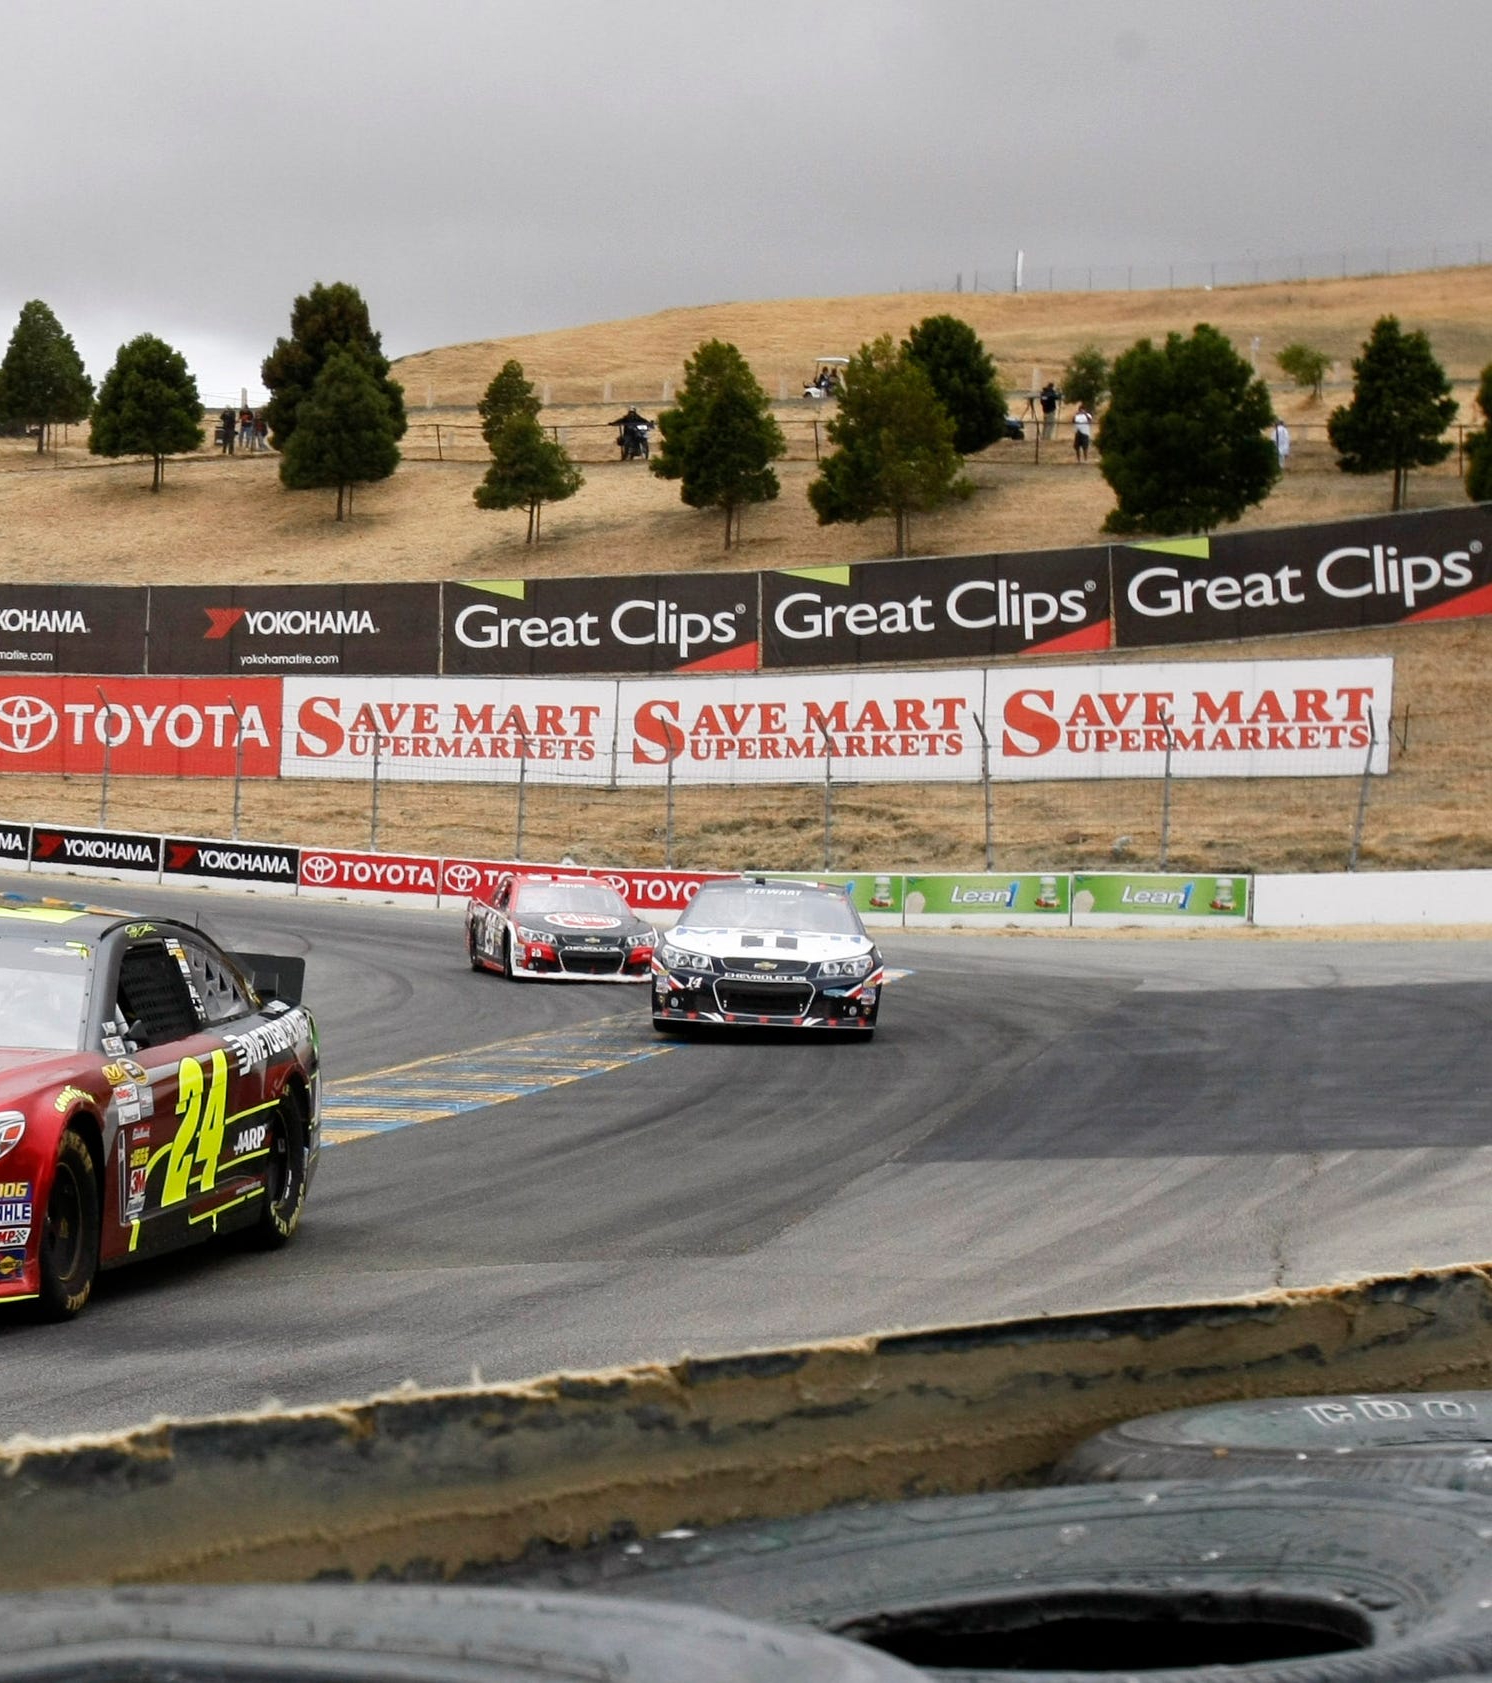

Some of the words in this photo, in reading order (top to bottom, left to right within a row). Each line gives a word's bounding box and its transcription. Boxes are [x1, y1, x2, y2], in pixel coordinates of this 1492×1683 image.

[1128, 565, 1305, 617] Great
[1317, 544, 1474, 607] Clips
[245, 610, 375, 635] YOKOHAMA
[774, 592, 935, 640] Great
[946, 579, 1087, 640] Clips
[455, 604, 600, 649] Great
[610, 600, 736, 658] Clips
[240, 654, 339, 666] yokohamatire.com
[64, 703, 271, 748] TOYOTA
[296, 696, 439, 758] SAVE
[453, 703, 600, 737] MART
[632, 699, 787, 764] SAVE
[803, 698, 966, 734] MART
[1002, 689, 1175, 758] SAVE
[1192, 687, 1374, 724] MART
[64, 838, 153, 863] YOKOHAMA
[197, 850, 291, 875] YOKOHAMA
[340, 860, 435, 888] TOYOTA
[632, 878, 701, 902] TOYO
[685, 976, 703, 990] 14
[161, 1049, 228, 1208] 24
[233, 1125, 266, 1155] AARP
